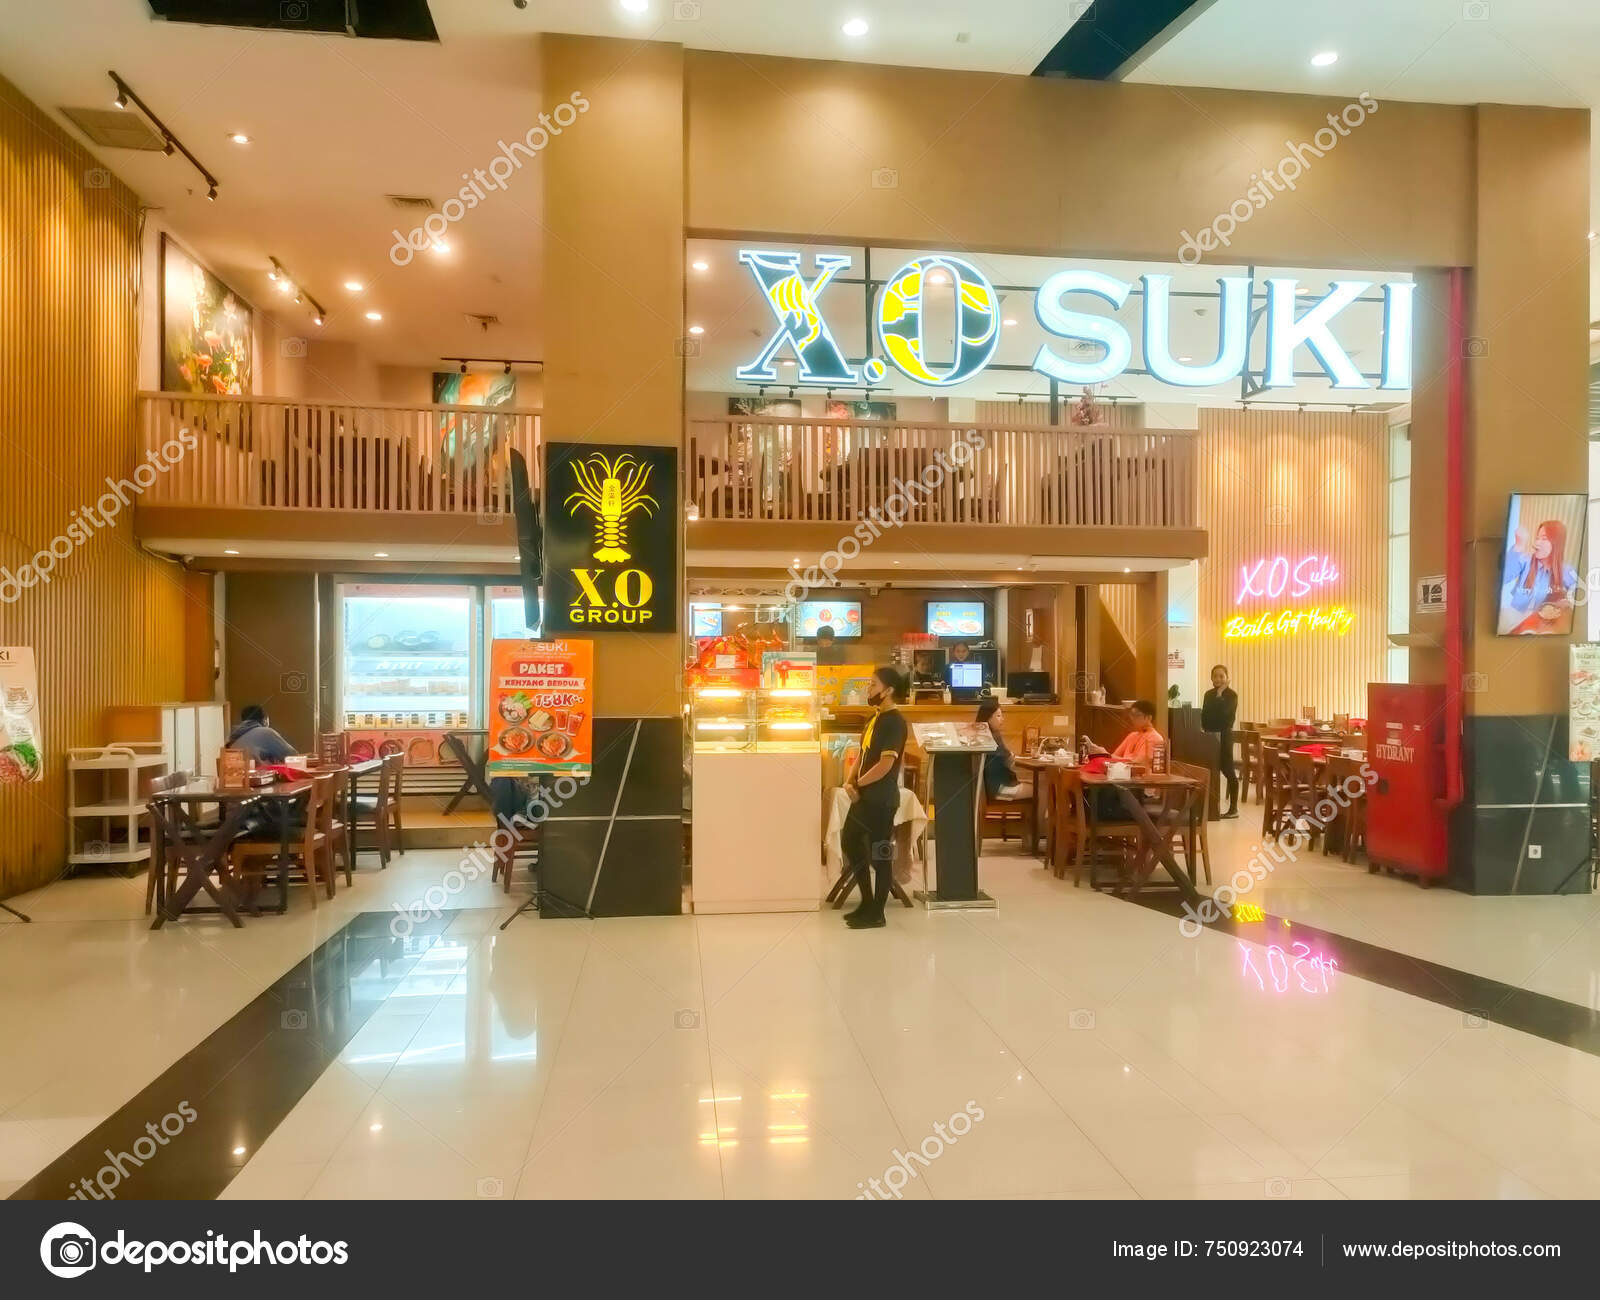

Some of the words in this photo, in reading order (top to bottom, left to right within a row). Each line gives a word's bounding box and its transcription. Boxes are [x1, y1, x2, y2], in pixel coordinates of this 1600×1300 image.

[736, 249, 1001, 387] X.O
[1032, 268, 1417, 390] SUKI
[1291, 555, 1339, 597] Suki
[569, 568, 653, 608] X.O
[569, 608, 653, 624] GROUP
[1277, 610, 1308, 635] Get
[536, 642, 568, 652] SUKI
[519, 663, 564, 675] PAKET
[1376, 744, 1415, 764] HYDRANT
